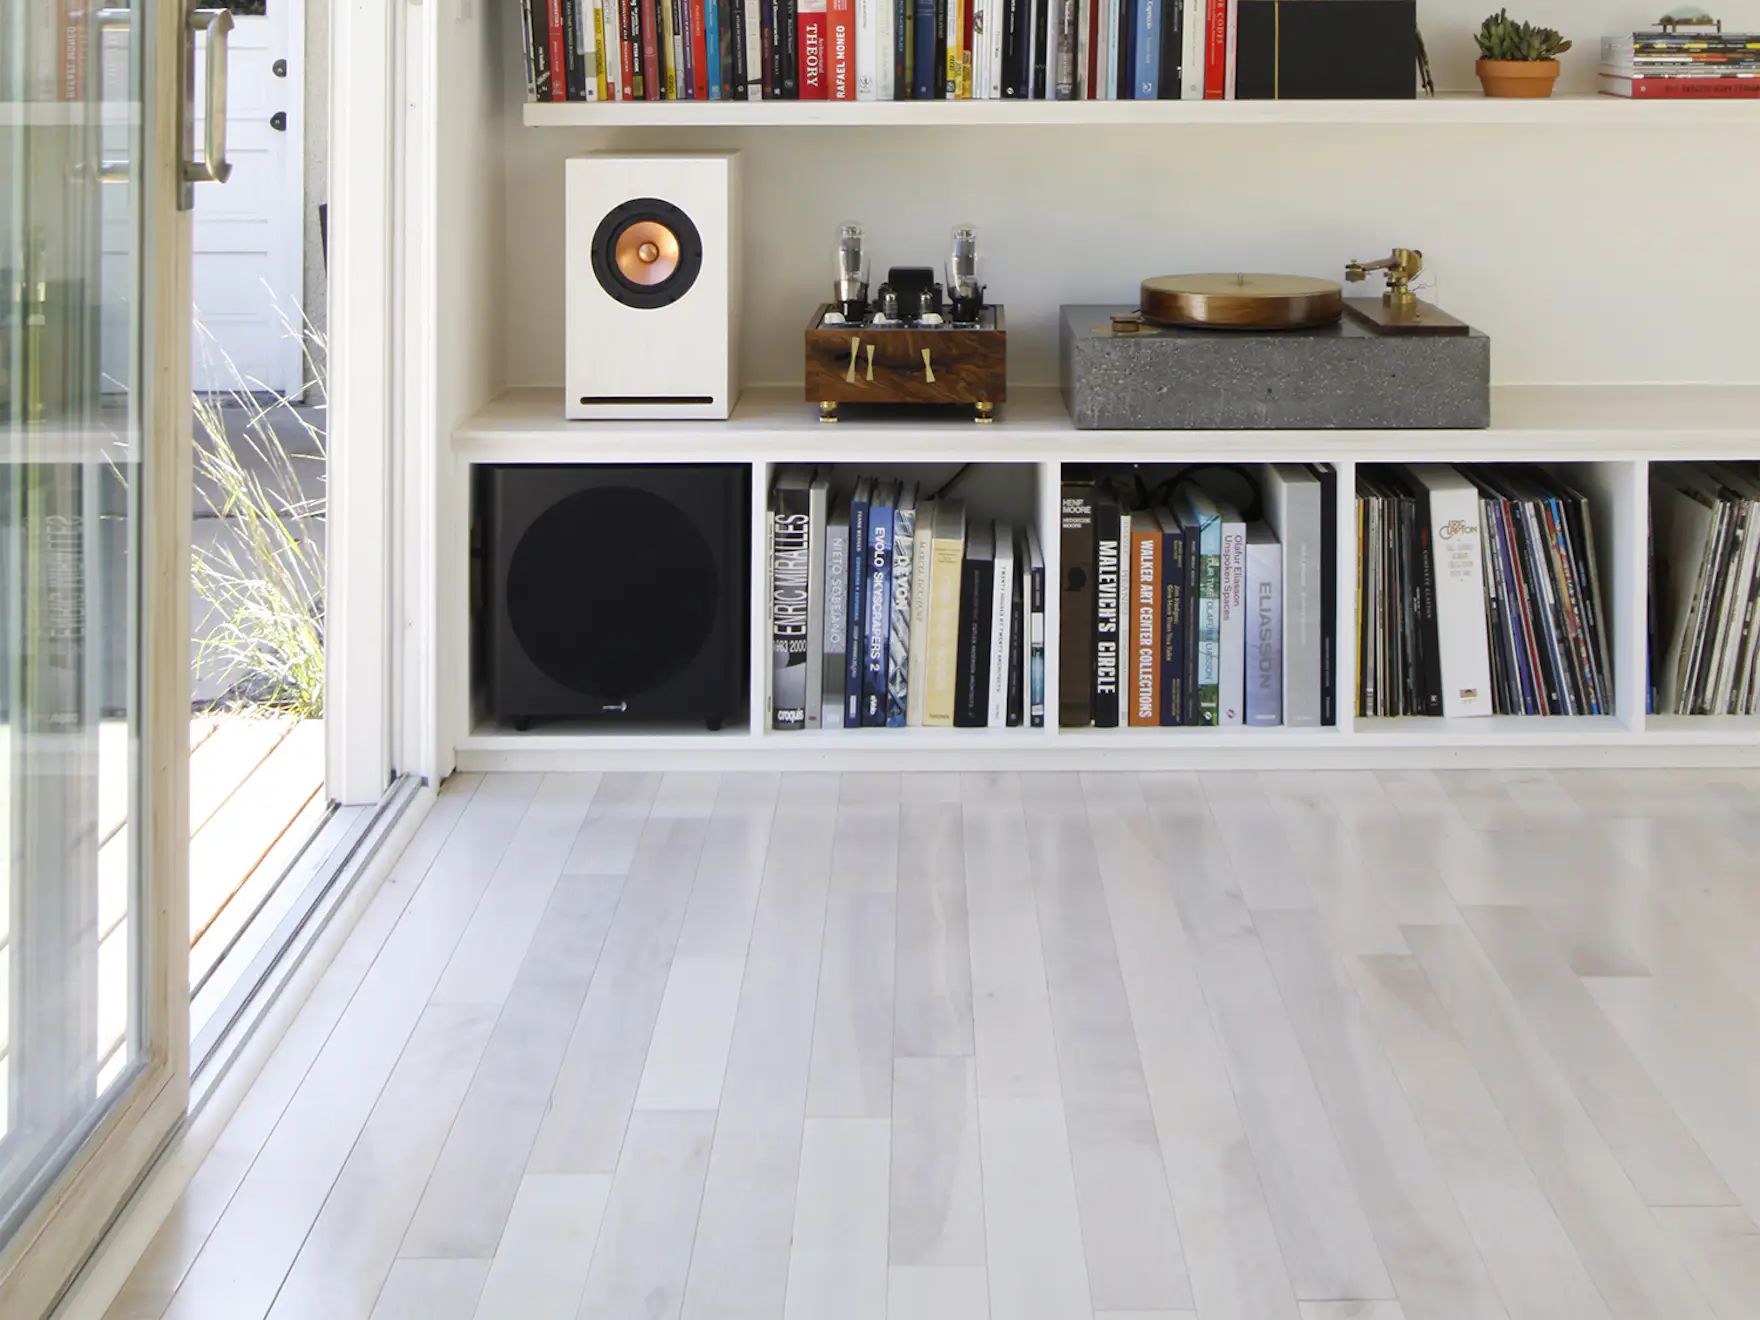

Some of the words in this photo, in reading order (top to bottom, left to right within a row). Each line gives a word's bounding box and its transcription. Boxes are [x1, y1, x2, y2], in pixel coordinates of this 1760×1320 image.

[806, 23, 817, 87] THEORY
[836, 25, 845, 59] MONEO
[836, 62, 845, 98] RAFAEL
[1062, 506, 1091, 514] MOORE
[774, 514, 809, 588] MIRALLES
[832, 537, 843, 574] NIETO
[874, 527, 885, 567] EVOLO
[1140, 540, 1154, 581] WALKER
[1207, 554, 1216, 576] YOUR
[1223, 535, 1233, 584] Unspoken
[1234, 535, 1243, 564] Olafur
[1098, 540, 1118, 633] MALEVICH'S
[1140, 584, 1153, 604] ART
[1206, 578, 1215, 597] TIME
[1222, 586, 1231, 621] Spaces
[1233, 567, 1242, 607] Eliasson
[774, 591, 807, 636] ENRIC
[830, 579, 842, 643] SOBEJANO
[871, 572, 885, 659] SKYSCRAPERS
[1139, 607, 1153, 646] CENTER
[788, 639, 807, 652] 2000
[1259, 582, 1272, 689] ELIASSON
[1097, 641, 1116, 694] CIRCLE
[1139, 648, 1153, 718] COLLECTIONS
[776, 709, 804, 721] croquis
